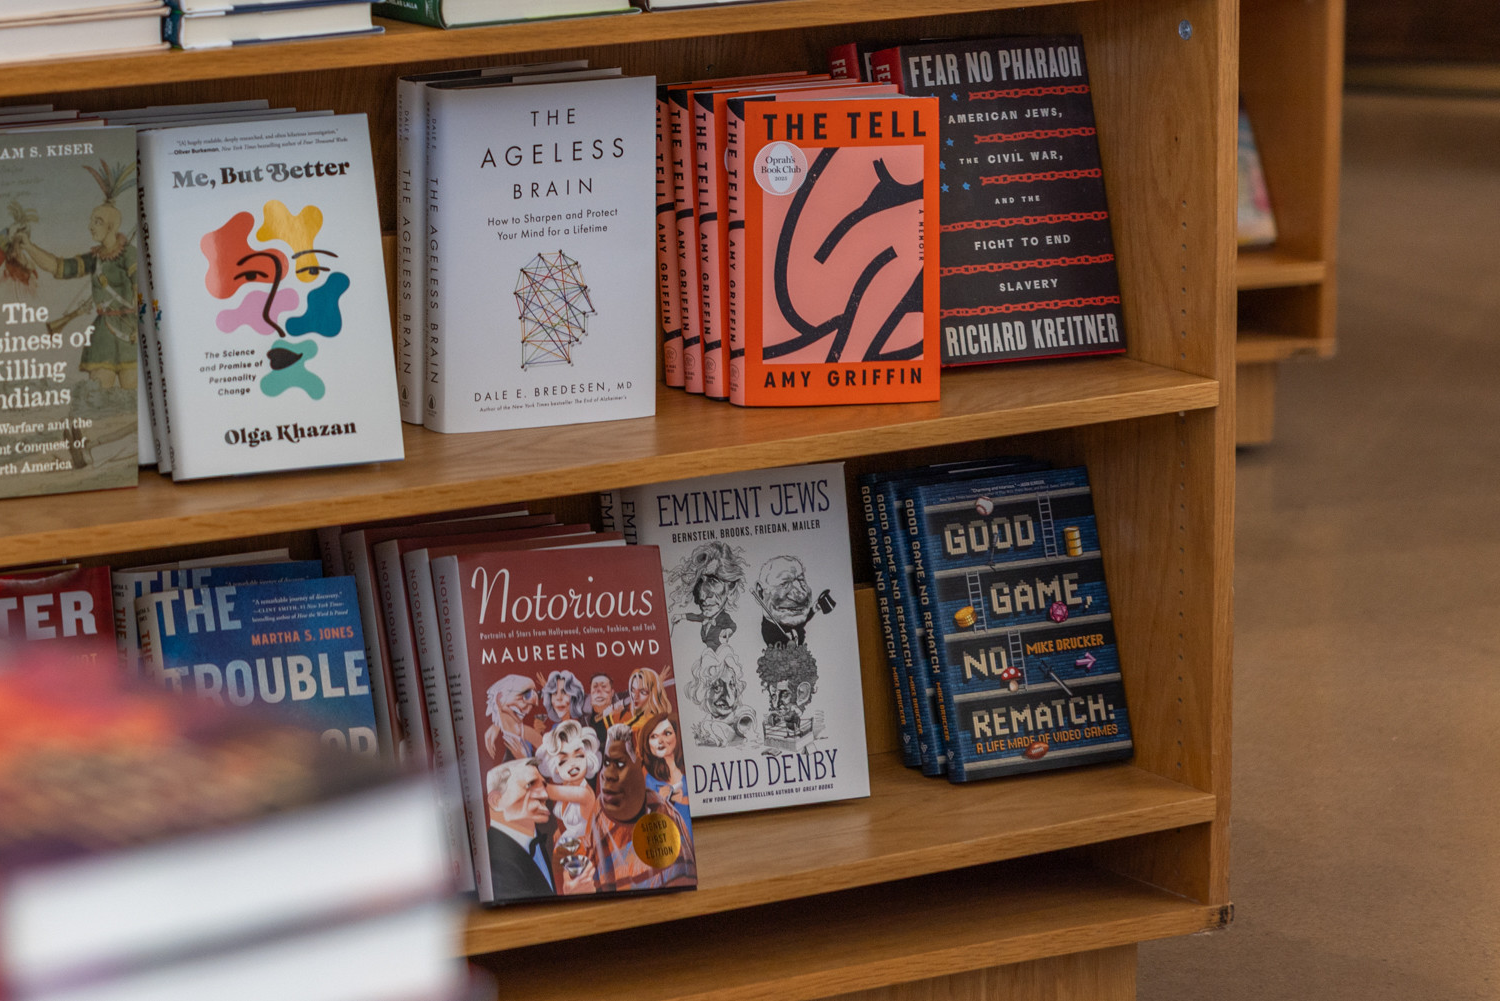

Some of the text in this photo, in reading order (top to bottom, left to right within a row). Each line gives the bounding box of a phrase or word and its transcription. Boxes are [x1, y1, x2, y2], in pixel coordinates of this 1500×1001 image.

[908, 46, 1083, 88] FEAR NO PHARAOH
[530, 108, 576, 127] THE
[763, 111, 926, 141] THE TELL
[948, 108, 1063, 124] AMERICAN JEWS,
[30, 147, 42, 158] S.
[47, 142, 94, 158] KISER
[480, 138, 624, 168] AGELESS
[765, 156, 796, 165] Oprah's
[959, 151, 1064, 165] THE CIVIL WAR,
[172, 161, 350, 189] Me, But Better
[760, 165, 801, 174] Book Club
[513, 178, 592, 199] BRAIN
[995, 197, 1015, 205] AND
[488, 209, 618, 226] How to Sharpen and Protect
[498, 231, 517, 241] Your
[521, 228, 545, 238] Mind
[548, 228, 560, 236] for
[573, 224, 607, 234] Lifetime
[975, 235, 1071, 250] FIGHT TO END
[999, 279, 1059, 292] SLAVERY
[2, 303, 49, 325] The
[70, 326, 95, 347] of
[945, 314, 1120, 357] RICHARD KREITNER
[764, 368, 922, 388] AMY GRIFFIN
[474, 391, 507, 402] DALE
[516, 389, 526, 399] E.
[534, 382, 610, 397] BREDESEN,
[47, 419, 69, 431] and
[73, 417, 92, 429] the
[225, 422, 357, 448] Olga Khazan
[15, 439, 70, 455] Conquest
[74, 437, 86, 449] of
[21, 459, 72, 473] America
[657, 480, 830, 527] EMINENT JEWS
[672, 520, 821, 543] BERNSTEIN, BROOKS, FRIEDAN, MAILER
[944, 514, 1036, 556] GOOD
[471, 566, 653, 624] Notorious
[990, 573, 1093, 615] GAME,
[153, 586, 242, 637] THE
[252, 626, 353, 646] MARTHA S. JONES
[1026, 634, 1104, 655] MIKE DRUCKER
[482, 639, 659, 665] MAUREEN DOWD
[963, 646, 1007, 679] NO
[162, 650, 369, 707] TROUBLE
[972, 694, 1116, 739] REMATCH:
[693, 749, 838, 794] DAVID DENBY
[642, 820, 667, 832] SIGNED
[647, 834, 667, 845] FIRST
[645, 847, 673, 859] EDITION
